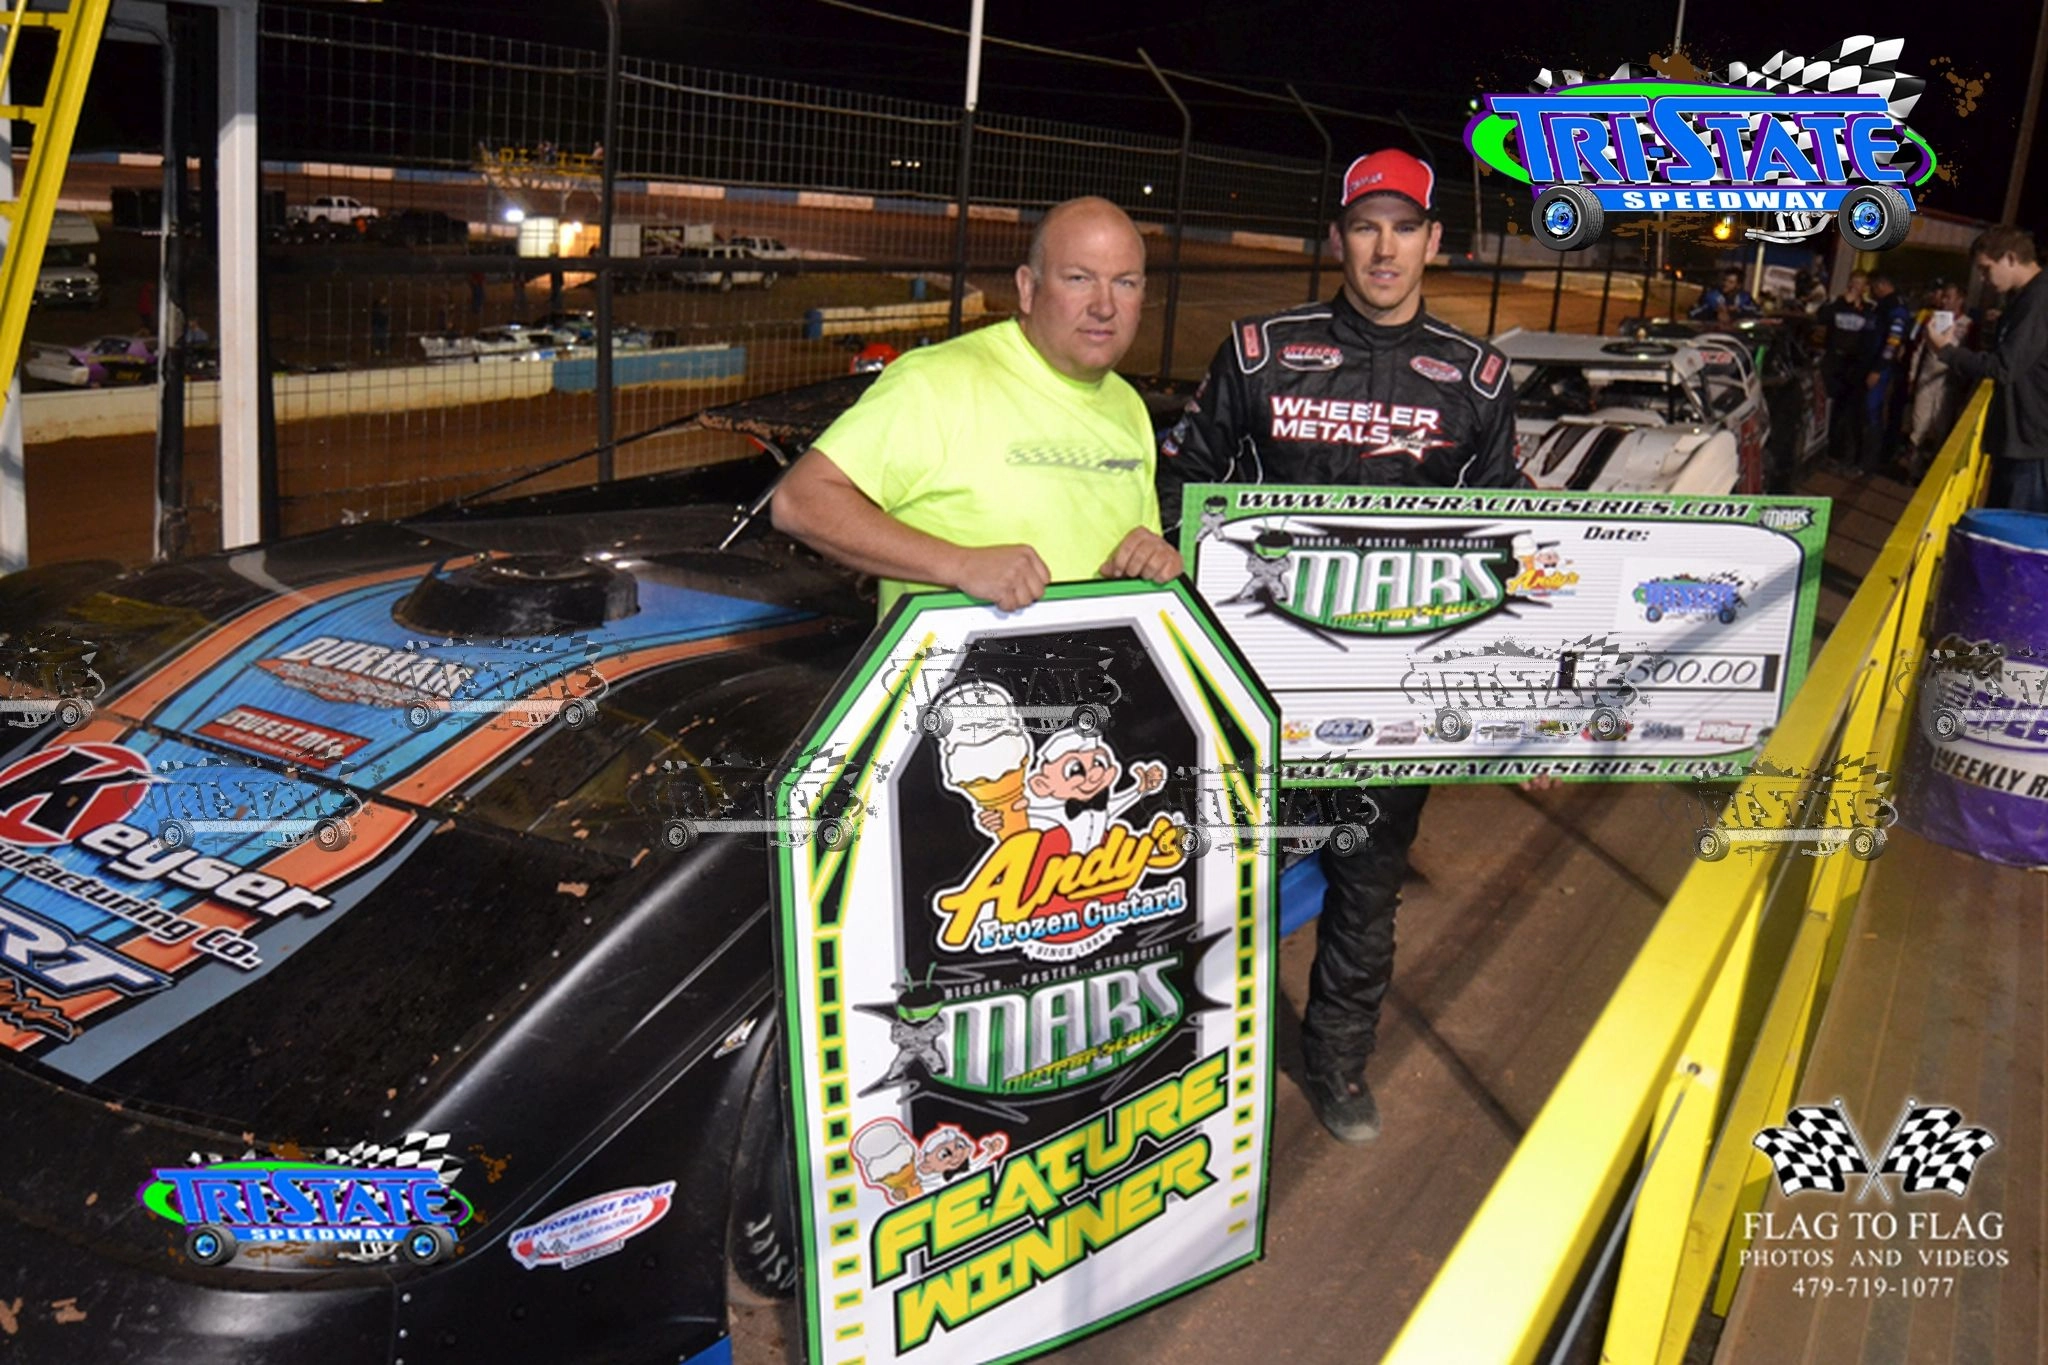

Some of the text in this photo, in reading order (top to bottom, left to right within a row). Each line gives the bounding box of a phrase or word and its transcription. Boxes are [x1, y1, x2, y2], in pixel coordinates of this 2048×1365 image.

[1270, 396, 1440, 430] WHEELER
[1271, 418, 1391, 445] METALS
[1236, 491, 1753, 520] WWW.MARSRACINGSERIES.COM
[1583, 525, 1650, 542] Date:
[1288, 551, 1506, 628] MARS
[216, 709, 307, 742] SWEET
[1933, 747, 2026, 792] WEEKLY
[0, 843, 263, 970] ufacturing Co.
[940, 816, 1185, 945] Andy's
[979, 882, 1184, 950] Frozen Custard
[1036, 945, 1073, 957] SINCE
[938, 957, 1182, 1086] MARS
[873, 1049, 1229, 1287] FEATURE
[513, 1201, 617, 1242] PERFORMANCE
[621, 1184, 671, 1207] BODIES
[895, 1134, 1217, 1356] WINNER
